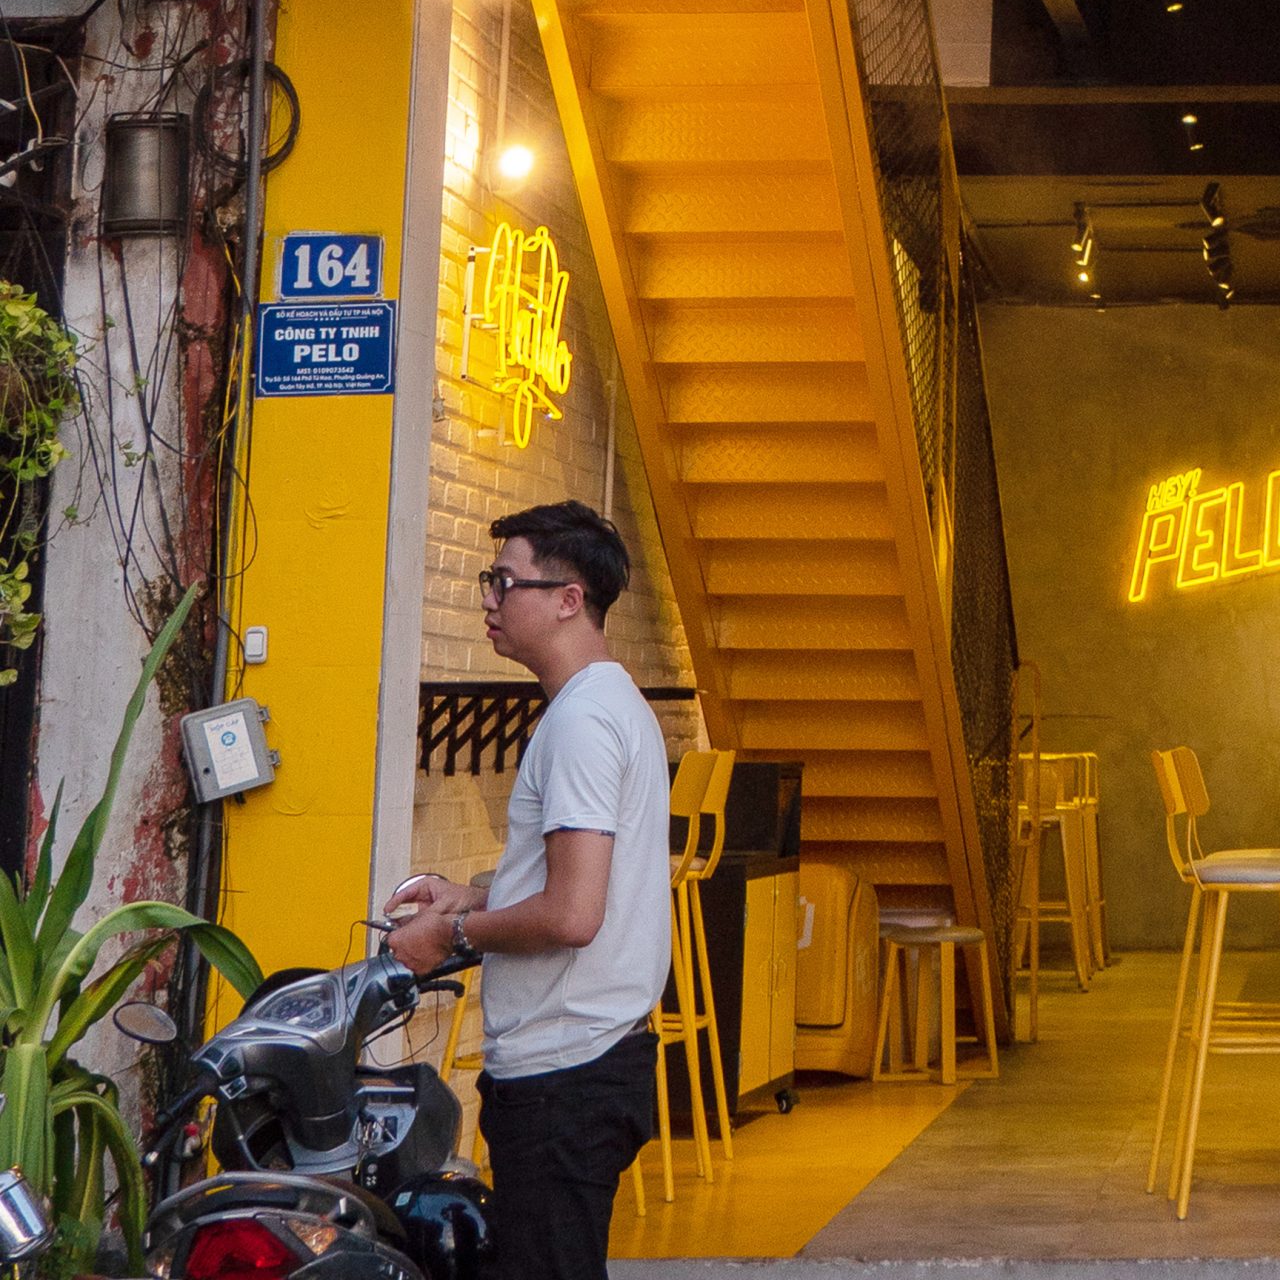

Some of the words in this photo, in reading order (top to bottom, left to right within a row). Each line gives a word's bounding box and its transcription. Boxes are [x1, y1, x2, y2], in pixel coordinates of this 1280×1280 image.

[293, 243, 371, 289] 164
[274, 326, 316, 341] CÔNG
[319, 327, 337, 340] TY
[340, 326, 380, 339] TNHH
[293, 343, 360, 363] PELO
[1147, 468, 1202, 511] HEY!
